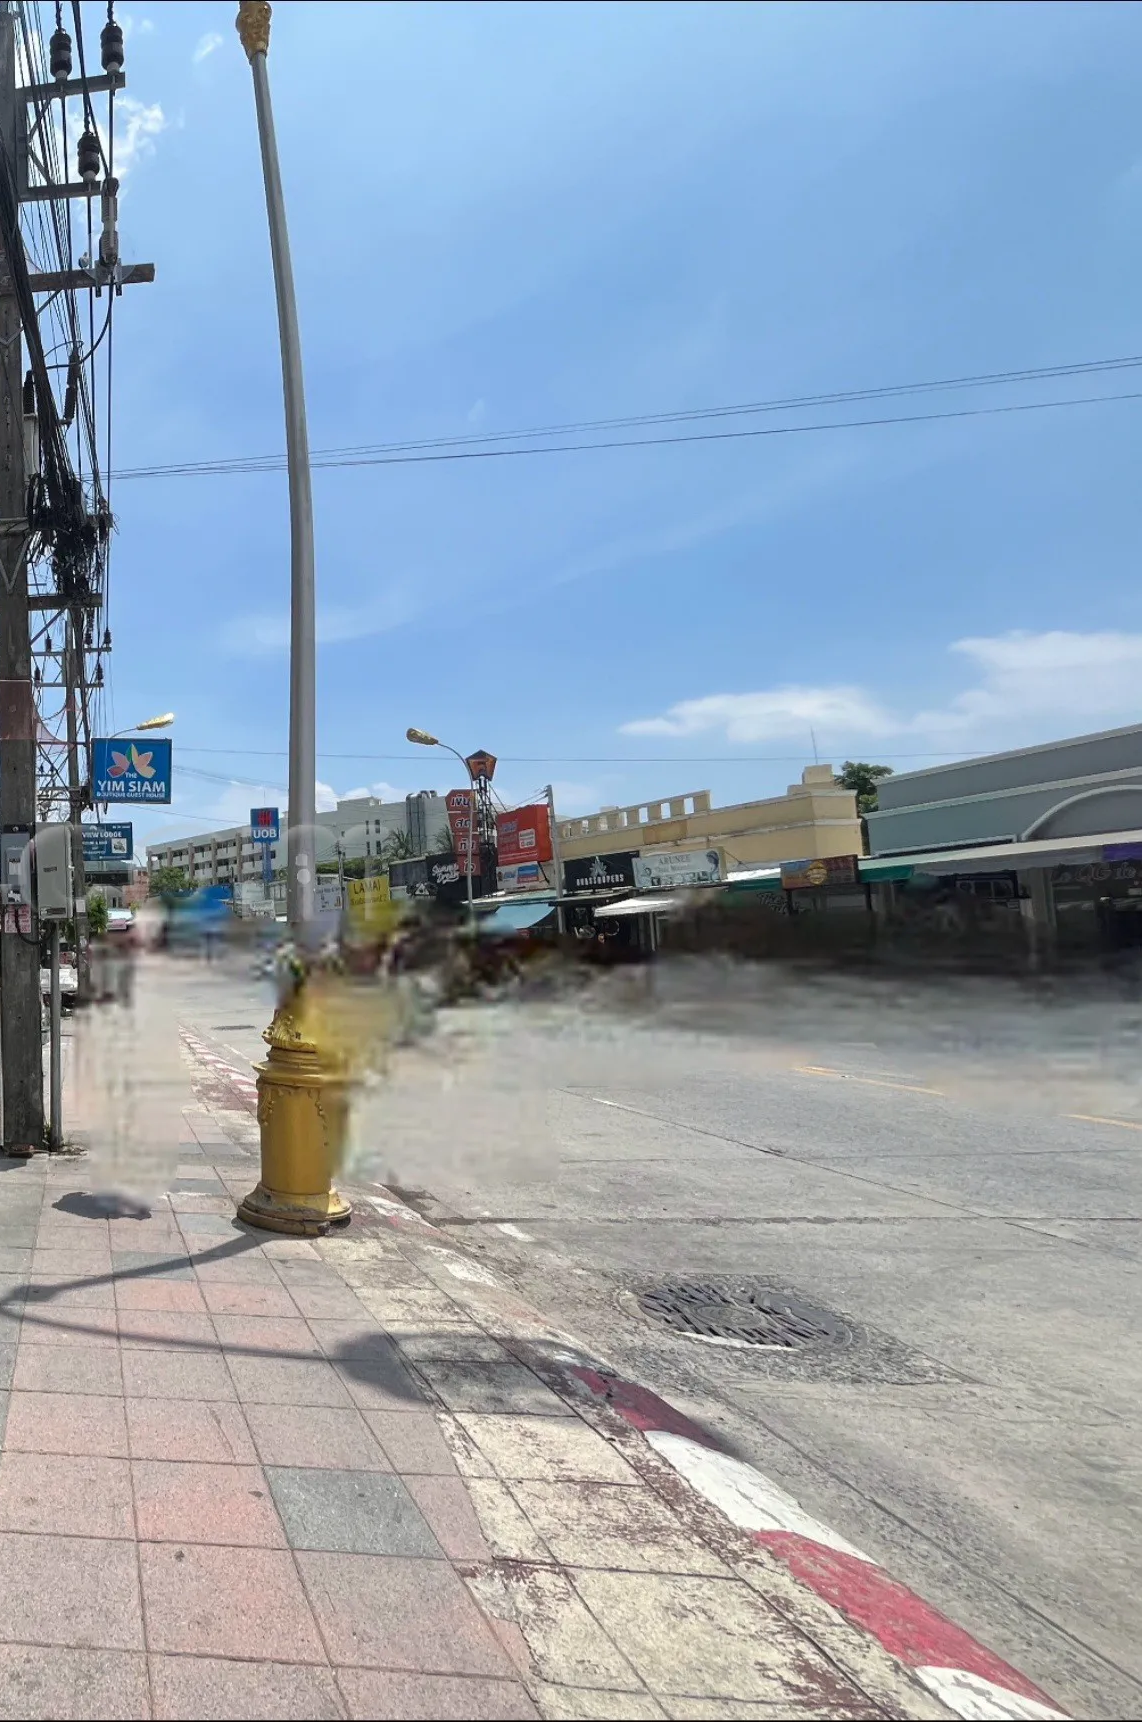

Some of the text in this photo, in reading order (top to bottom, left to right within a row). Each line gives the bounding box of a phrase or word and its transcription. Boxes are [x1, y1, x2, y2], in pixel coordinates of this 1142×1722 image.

[124, 771, 138, 779] THE
[97, 779, 166, 793] YIM SIAM
[253, 829, 277, 839] UOB
